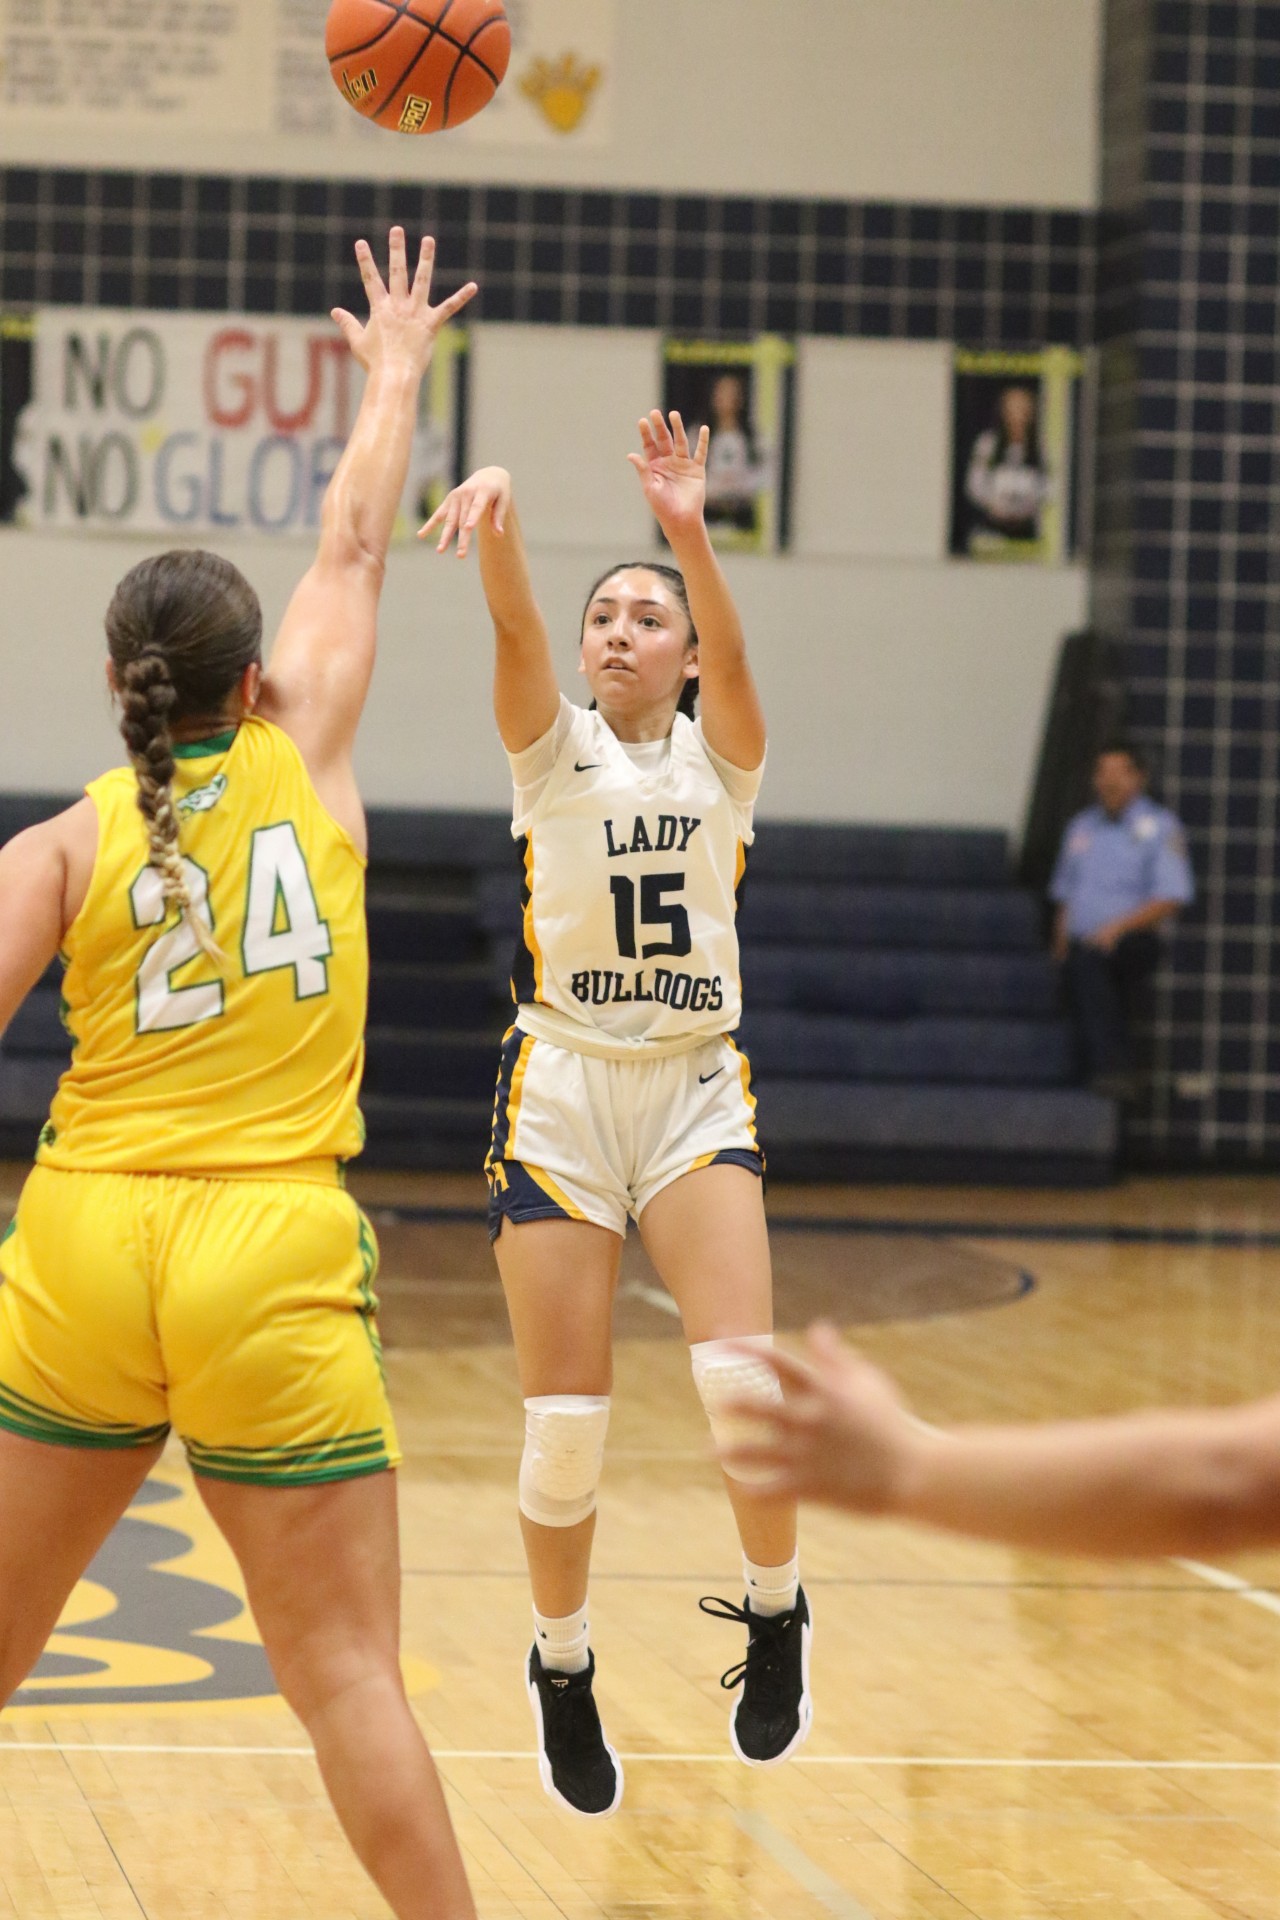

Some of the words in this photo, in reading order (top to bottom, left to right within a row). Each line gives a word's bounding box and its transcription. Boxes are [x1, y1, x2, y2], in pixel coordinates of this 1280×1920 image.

[63, 326, 165, 420] NO
[203, 327, 356, 440] GUT
[43, 430, 138, 519] NO
[604, 814, 701, 857] LADY
[128, 819, 333, 1036] 24
[609, 872, 692, 960] 15
[571, 967, 724, 1012] BULLDOGS
